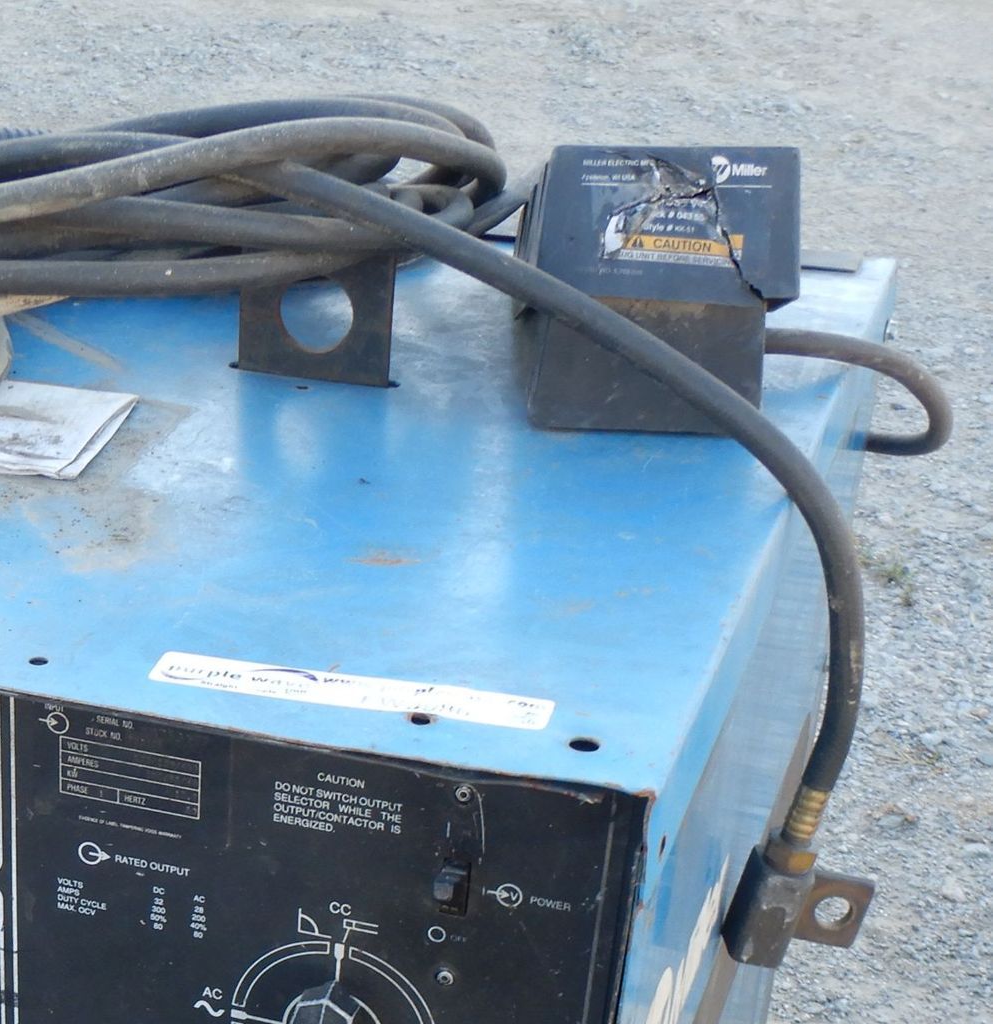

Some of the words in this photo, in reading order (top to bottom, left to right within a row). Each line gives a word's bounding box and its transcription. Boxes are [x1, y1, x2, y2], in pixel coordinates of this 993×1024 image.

[731, 163, 768, 177] Miller
[653, 238, 712, 252] CAUTION
[96, 716, 120, 727] SERIAL
[122, 720, 135, 730] NO.
[85, 727, 107, 738] STOCK
[110, 732, 122, 742] NO.
[67, 742, 88, 752] VOLTS
[67, 755, 100, 769] AMPERES
[66, 769, 79, 778] KW
[317, 772, 366, 789] CAUTION
[66, 783, 88, 795] PHASE
[275, 781, 290, 792] DO
[292, 784, 314, 796] NOT
[316, 788, 358, 805] SWITCH
[358, 796, 403, 812] OUTPUT
[124, 794, 147, 806] HERTZ
[274, 792, 330, 810] SELECTOR
[338, 804, 372, 818] WHILE
[380, 811, 402, 824] THE
[273, 812, 336, 833] ENERGIZED.
[274, 803, 385, 831] OUTPUT/CONTACTOR
[390, 825, 402, 835] IS
[114, 854, 148, 868] RATED
[149, 862, 190, 877] OUTPUT
[57, 877, 84, 890] VOLTS
[154, 897, 164, 906] 32
[194, 906, 204, 914] 28
[152, 886, 166, 895] DC
[193, 894, 206, 904] AC
[57, 886, 80, 897] AMPS
[152, 906, 166, 914] 300
[192, 913, 206, 923] 200
[78, 906, 96, 916] OCV
[328, 901, 352, 917] CC
[529, 895, 572, 912] POWER
[57, 894, 80, 906] DUTY
[80, 898, 107, 910] CYCLE
[190, 922, 208, 932] 40%
[202, 986, 224, 1000] AC
